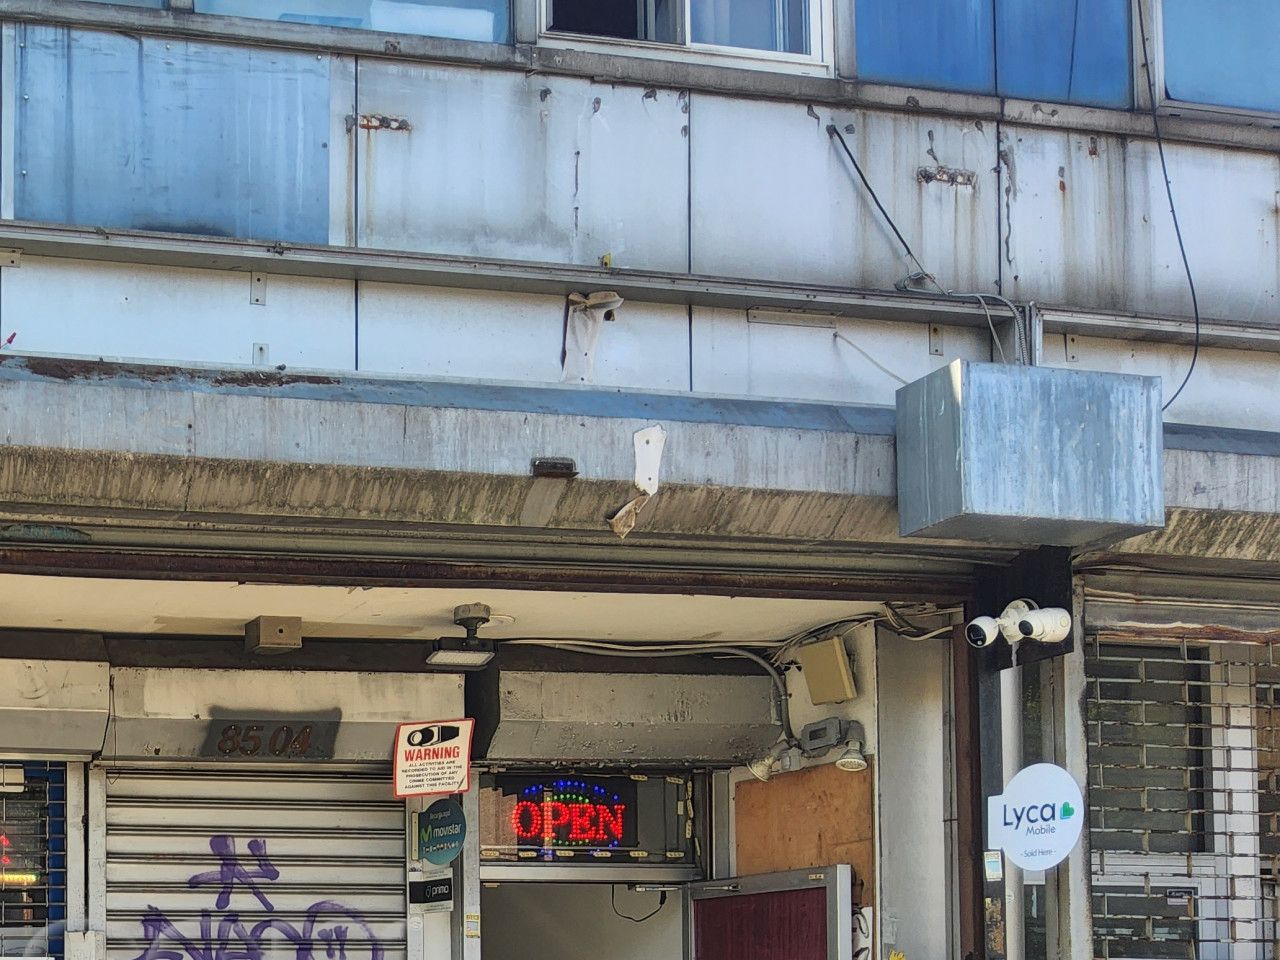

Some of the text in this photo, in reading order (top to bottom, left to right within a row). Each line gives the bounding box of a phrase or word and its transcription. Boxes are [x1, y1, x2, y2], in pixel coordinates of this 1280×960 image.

[405, 746, 460, 762] WARNING
[511, 800, 626, 841] OPEN
[1003, 802, 1056, 830] Lyca
[432, 822, 462, 838] movistar
[1025, 825, 1056, 837] Mobile
